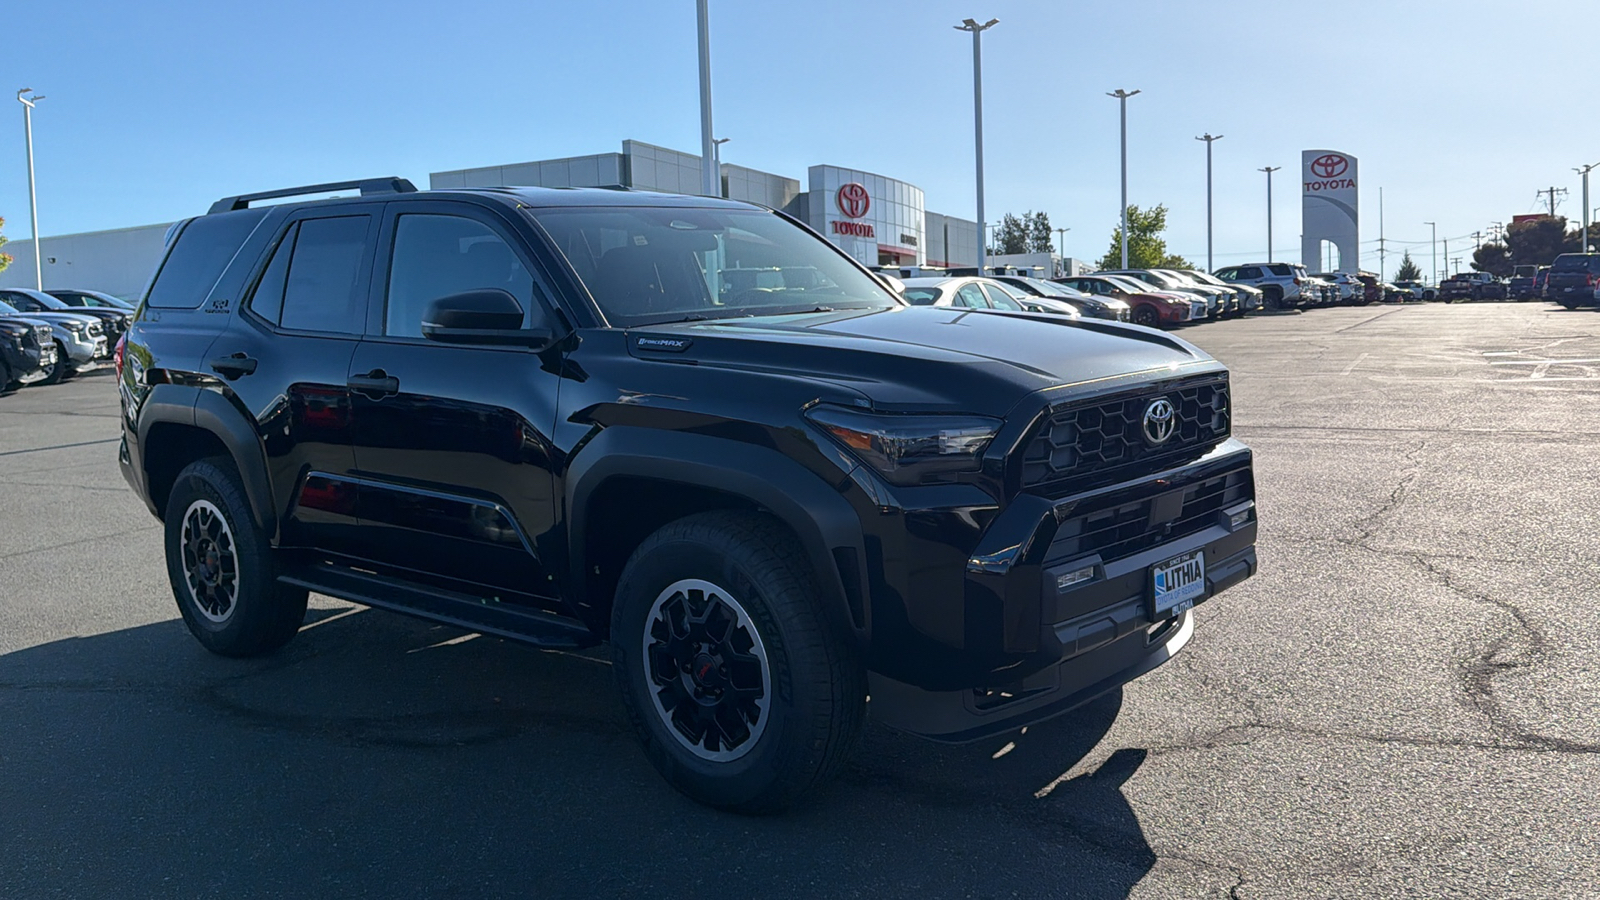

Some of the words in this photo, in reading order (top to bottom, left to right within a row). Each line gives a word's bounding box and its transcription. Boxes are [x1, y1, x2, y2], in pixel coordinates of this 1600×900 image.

[1304, 178, 1356, 192] TOYOTA
[832, 220, 875, 238] TOYOTA
[1165, 560, 1202, 592] LITHIA
[1174, 588, 1181, 599] OF
[1181, 580, 1203, 595] REDDING
